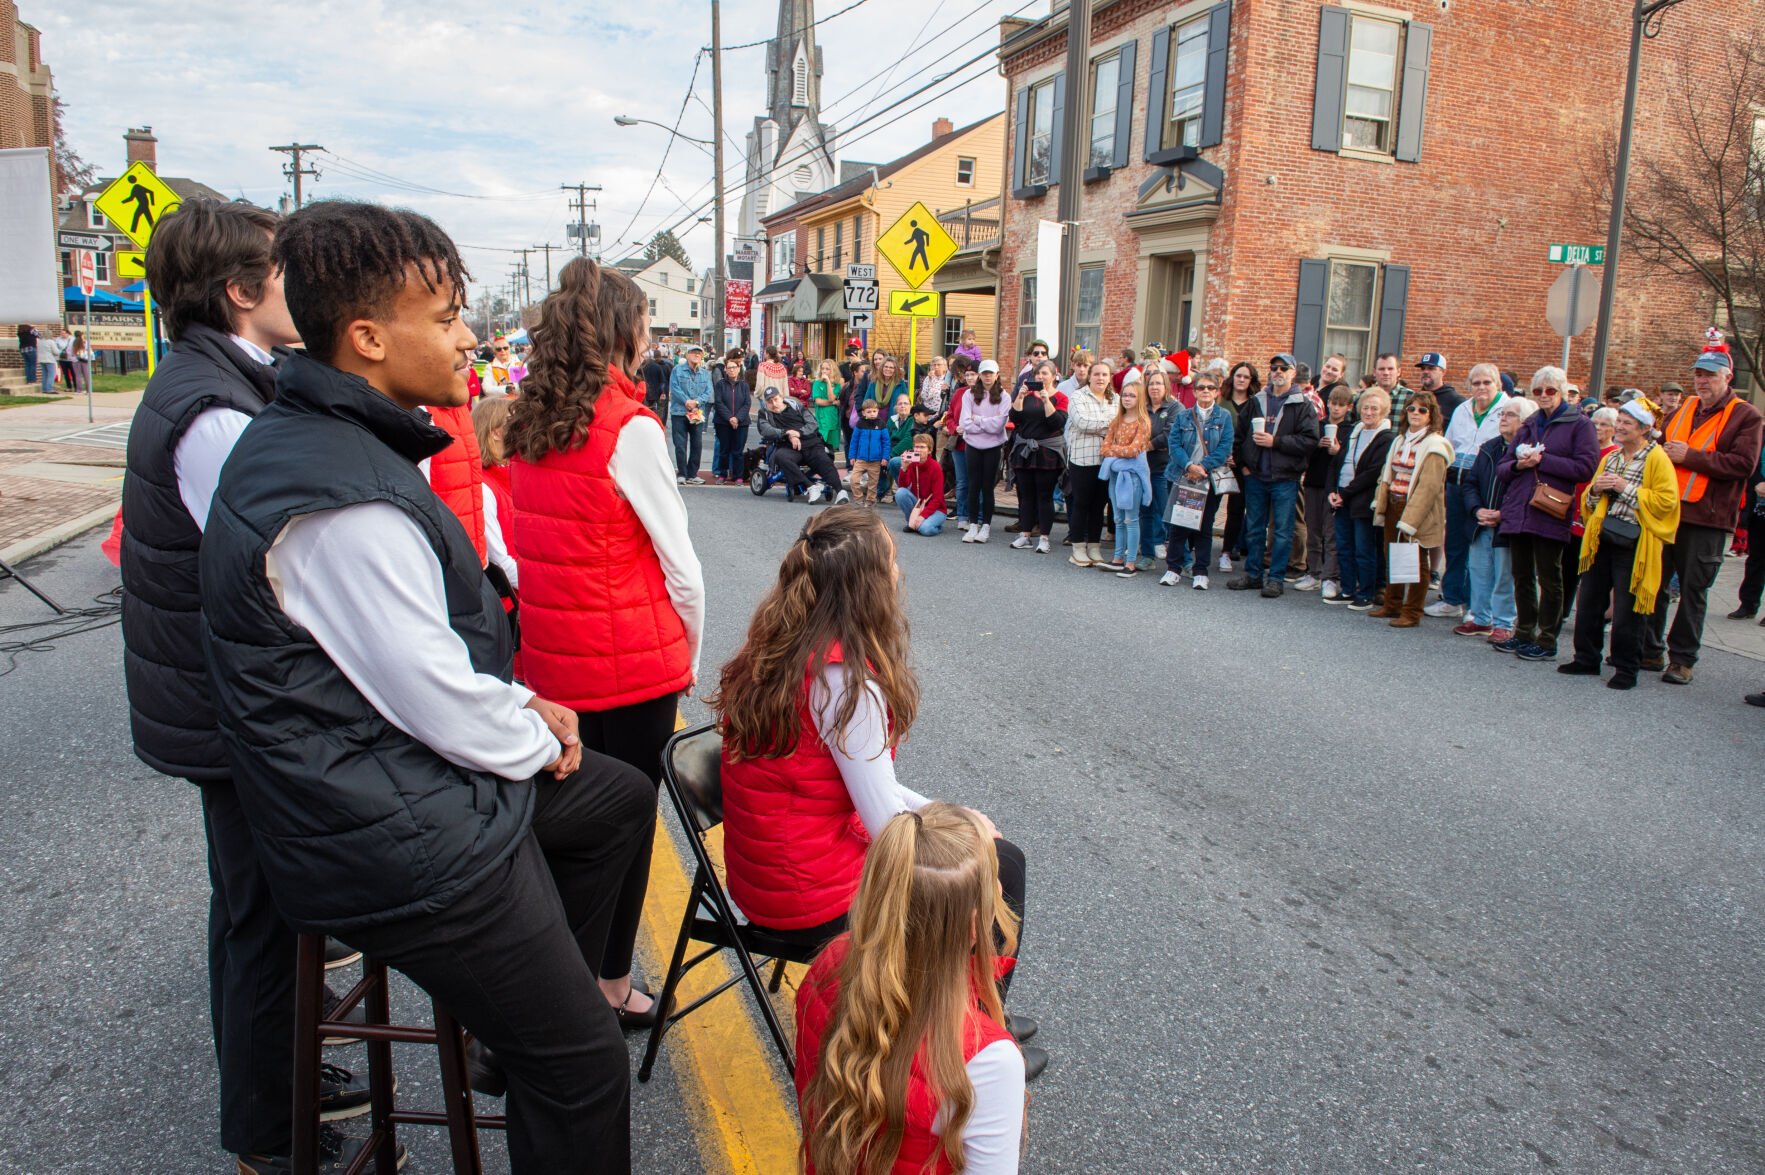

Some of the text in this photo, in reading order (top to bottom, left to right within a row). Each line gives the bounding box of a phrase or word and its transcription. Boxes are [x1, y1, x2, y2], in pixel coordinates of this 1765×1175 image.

[63, 235, 79, 244] ONE
[1567, 246, 1603, 262] DELTA ST
[850, 266, 873, 277] WEST
[846, 286, 875, 303] 772
[102, 315, 144, 323] MARK'S
